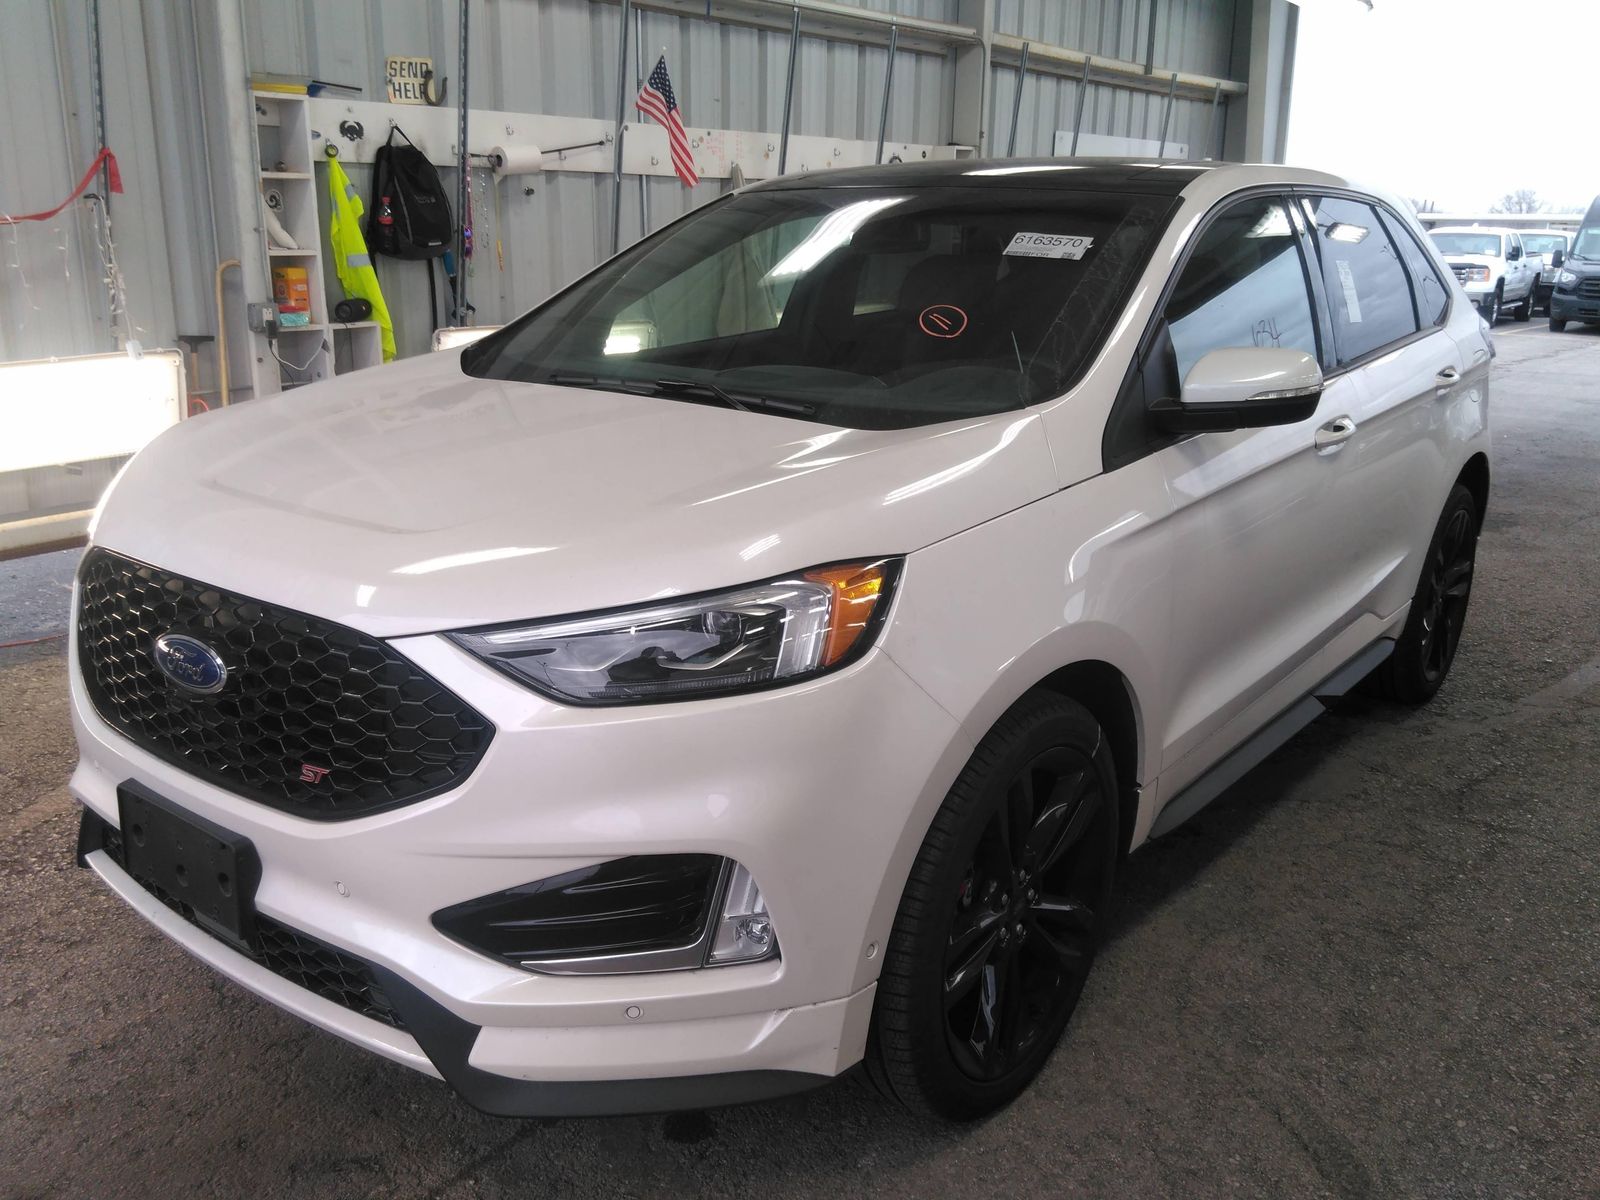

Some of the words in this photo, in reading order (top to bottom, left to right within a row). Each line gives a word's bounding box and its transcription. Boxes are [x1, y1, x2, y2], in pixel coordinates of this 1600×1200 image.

[389, 60, 430, 79] SEND
[1014, 234, 1083, 248] 6163570
[299, 763, 330, 784] ST
